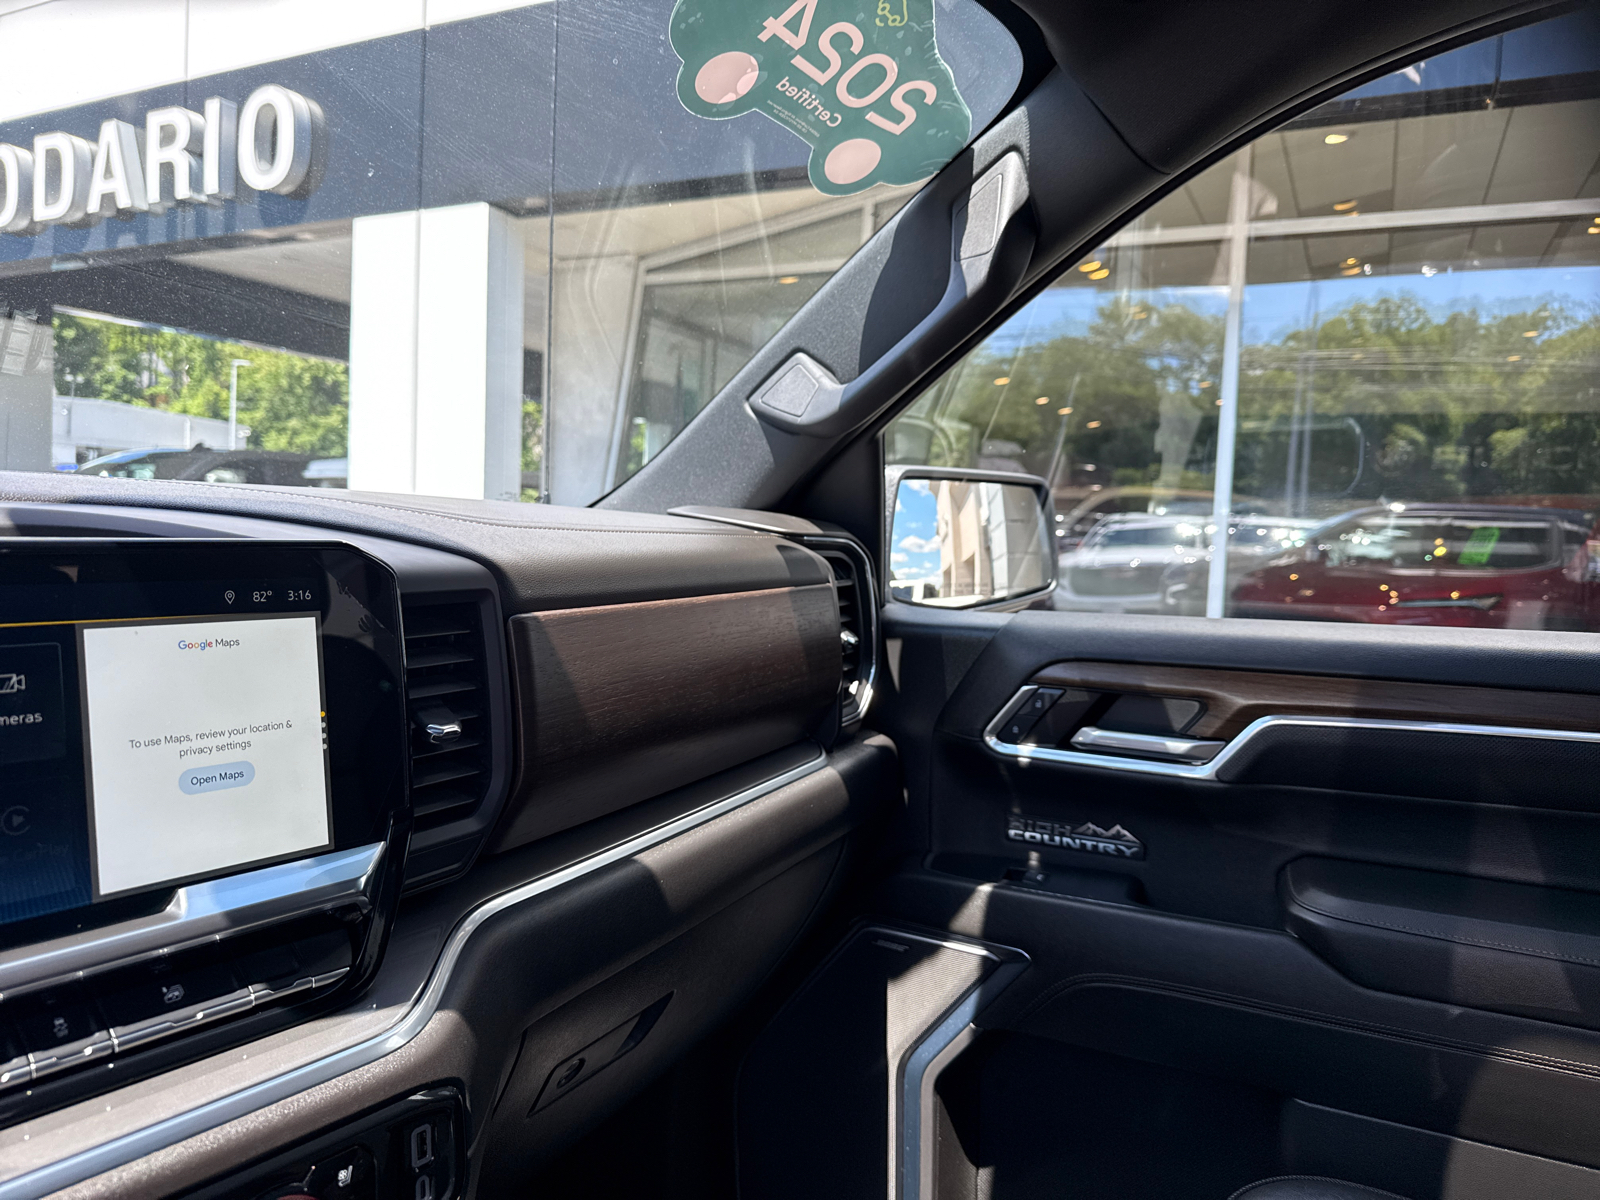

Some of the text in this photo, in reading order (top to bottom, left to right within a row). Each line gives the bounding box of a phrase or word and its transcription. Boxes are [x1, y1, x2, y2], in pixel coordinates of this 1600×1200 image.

[252, 590, 273, 602] 82°
[287, 590, 312, 601] 3:16
[178, 638, 240, 651] Google Maps
[129, 720, 293, 749] To use Maps, review your location &
[179, 740, 252, 759] privacy settings
[190, 770, 245, 787] Open Maps
[1007, 828, 1140, 857] COUNTRY
